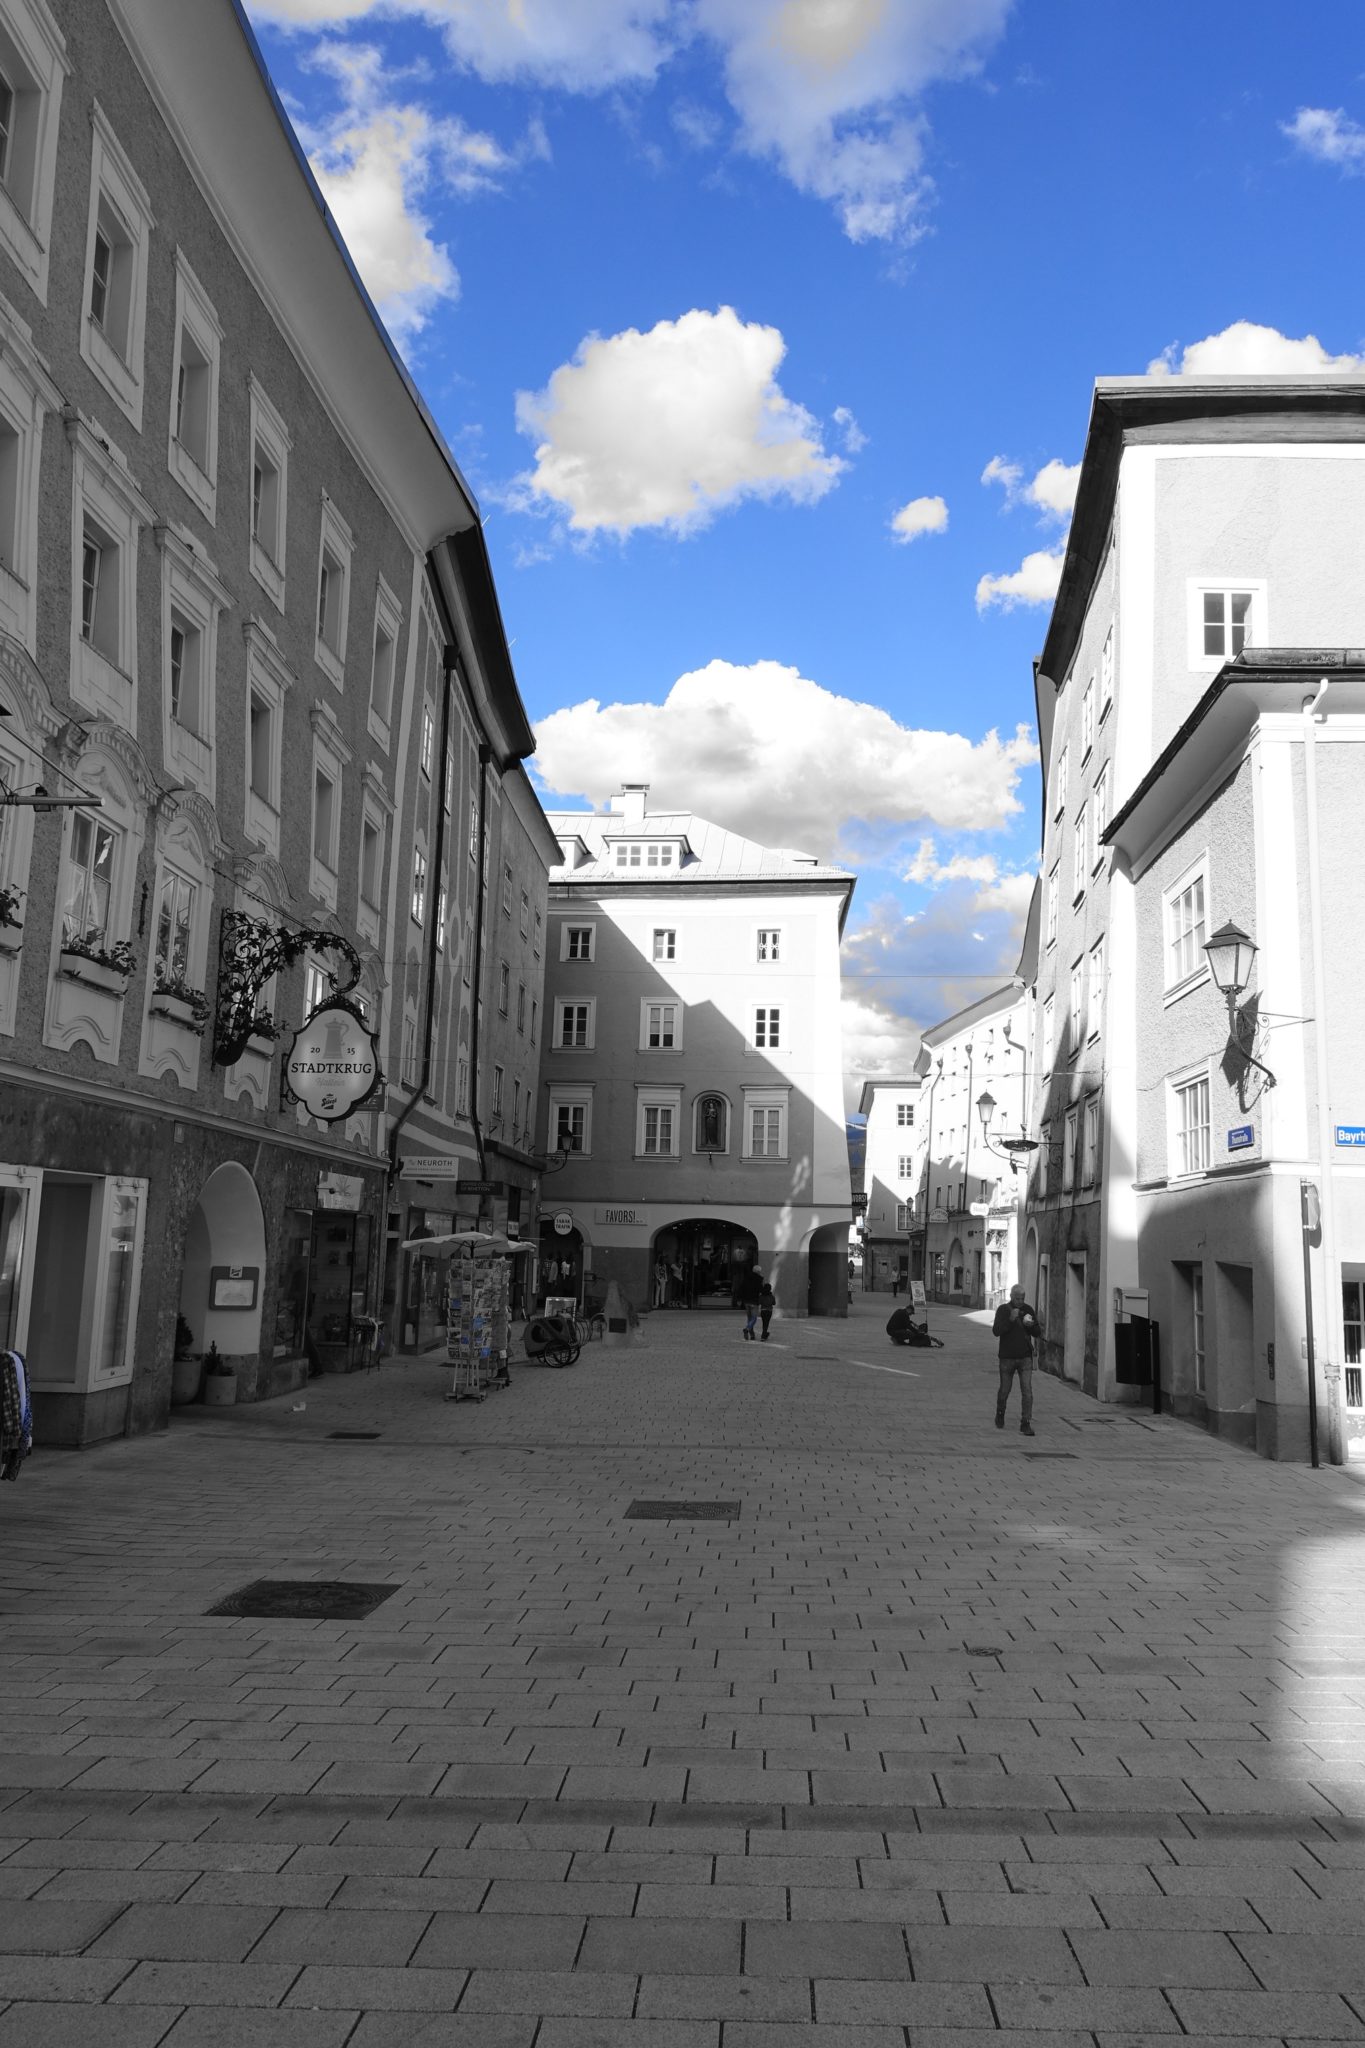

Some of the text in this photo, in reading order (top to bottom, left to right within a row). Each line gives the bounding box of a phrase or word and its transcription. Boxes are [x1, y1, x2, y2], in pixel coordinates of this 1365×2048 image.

[347, 1047, 356, 1055] 15
[291, 1062, 372, 1074] STADTKRUG
[417, 1159, 453, 1167] NEUROTH
[605, 1209, 635, 1224] FAVORS!
